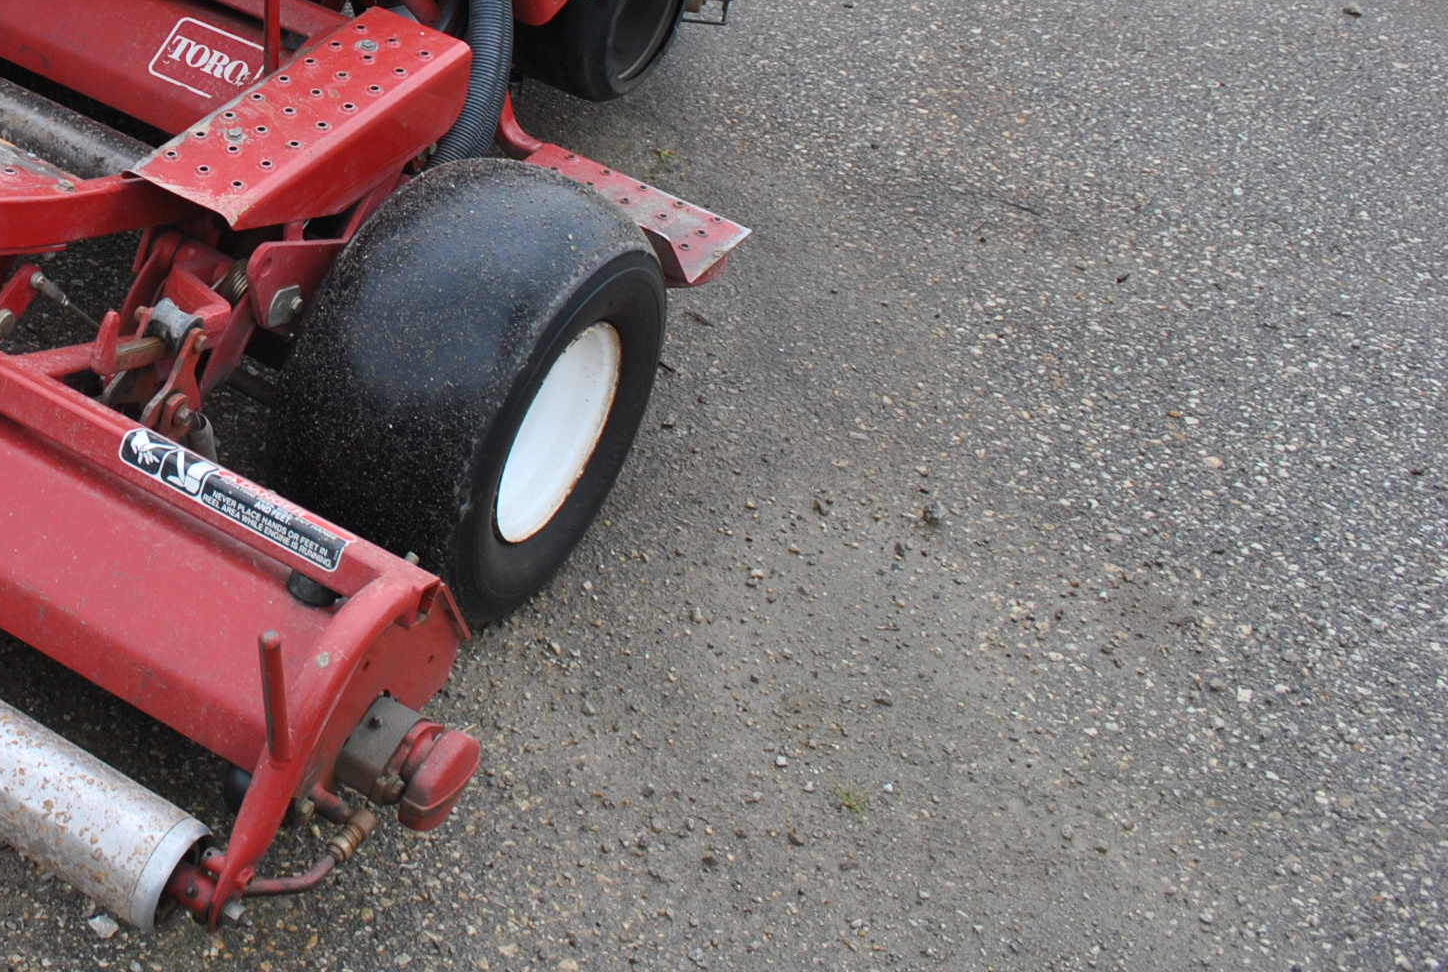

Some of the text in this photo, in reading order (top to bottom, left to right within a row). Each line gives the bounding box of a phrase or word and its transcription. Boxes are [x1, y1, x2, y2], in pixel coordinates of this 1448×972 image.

[167, 35, 249, 87] TORO
[203, 494, 219, 508] REEL
[220, 505, 241, 519] AREA
[242, 514, 263, 531] WHILE
[264, 527, 290, 545] ENGINE
[290, 541, 298, 549] IS
[213, 490, 235, 507] NEVER
[237, 503, 261, 521] PLACE
[262, 516, 287, 535] HANDS
[287, 530, 299, 540] OR
[300, 536, 319, 551] FEET
[319, 547, 328, 556] IN
[253, 501, 291, 525] AND FEET.
